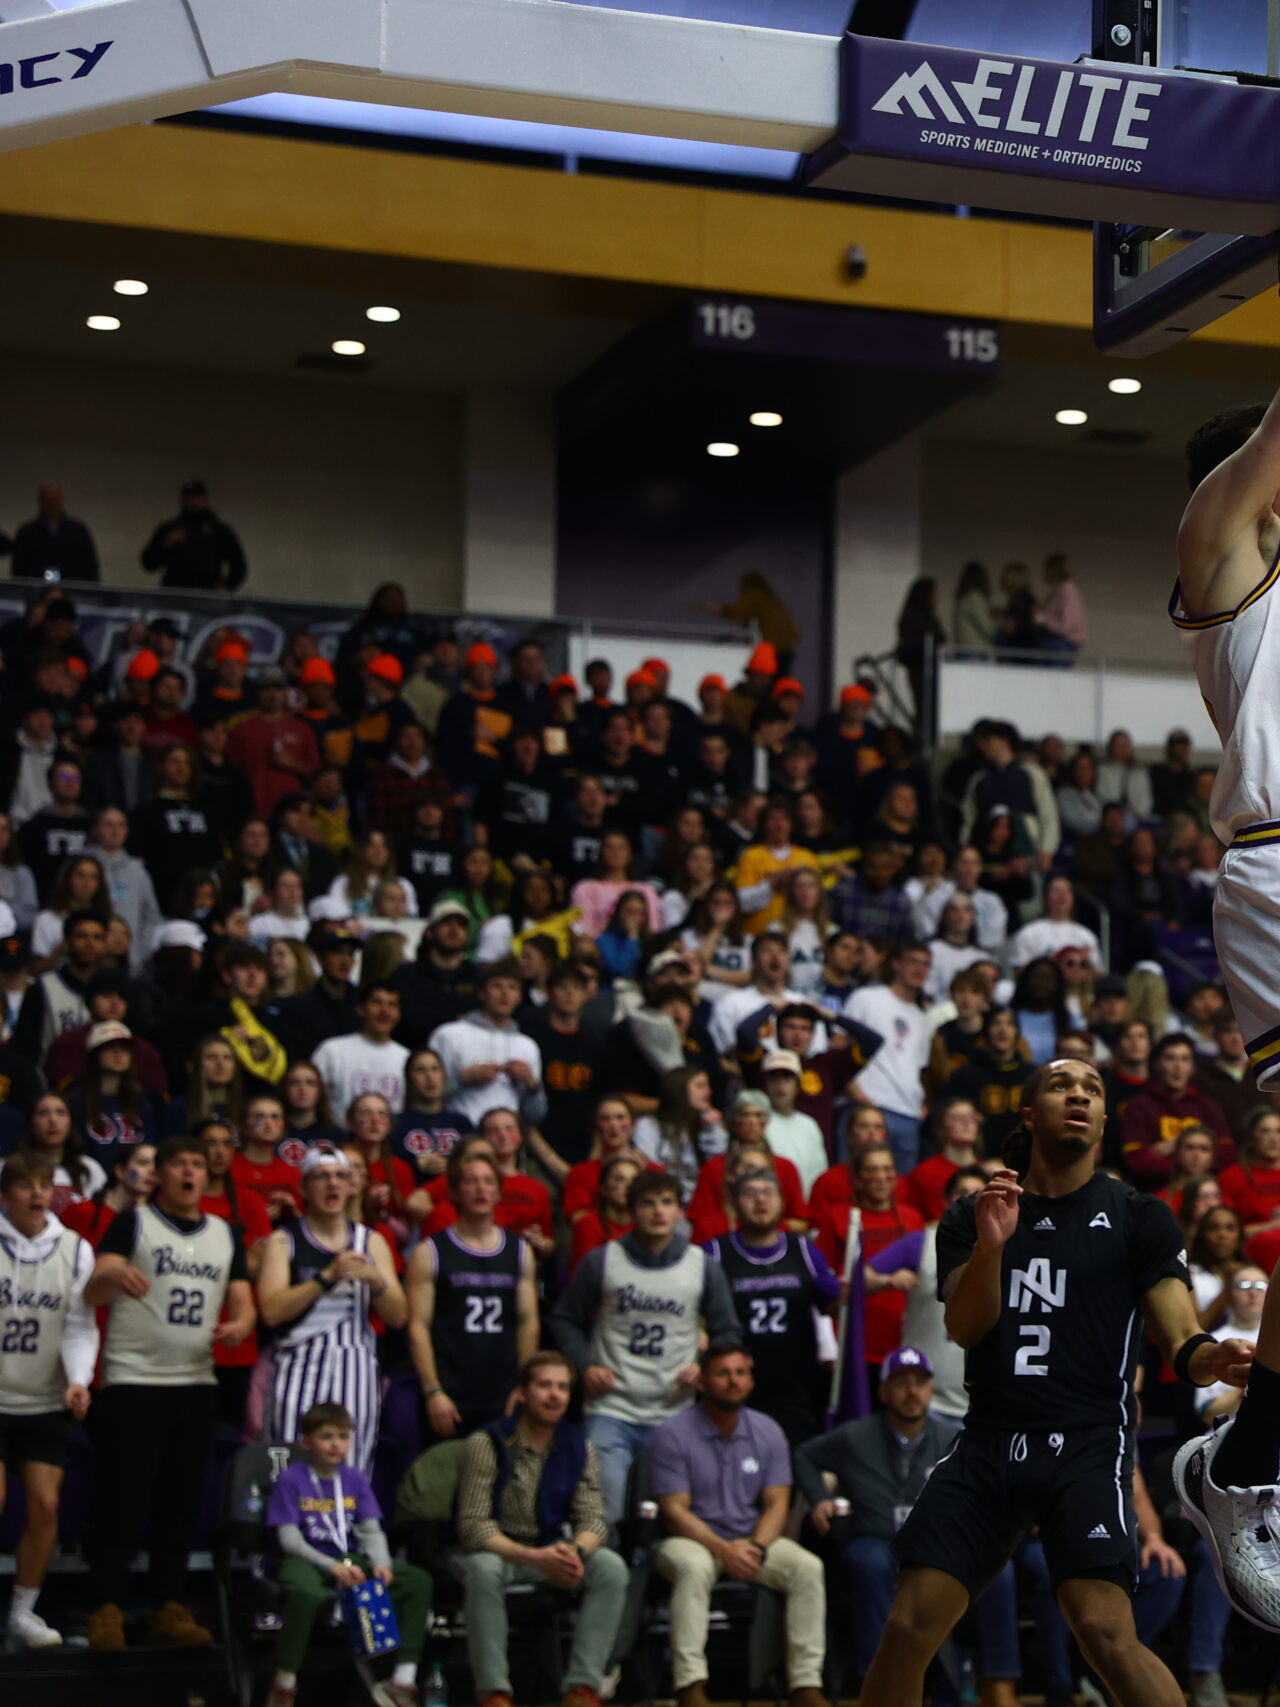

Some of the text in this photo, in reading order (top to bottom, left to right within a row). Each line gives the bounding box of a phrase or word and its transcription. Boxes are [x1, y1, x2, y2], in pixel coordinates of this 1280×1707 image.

[951, 58, 1163, 150] ELITE
[919, 129, 971, 149] SPORTS
[973, 137, 1041, 160] MEDICINE
[1052, 149, 1143, 173] ORTHOPEDICS
[698, 302, 756, 340] 116
[944, 326, 999, 363] 115
[168, 1288, 204, 1326] 22
[464, 1295, 504, 1334] 22
[750, 1297, 788, 1334] 22
[3, 1318, 40, 1353] 22
[631, 1322, 666, 1356] 22
[1014, 1324, 1051, 1377] 2
